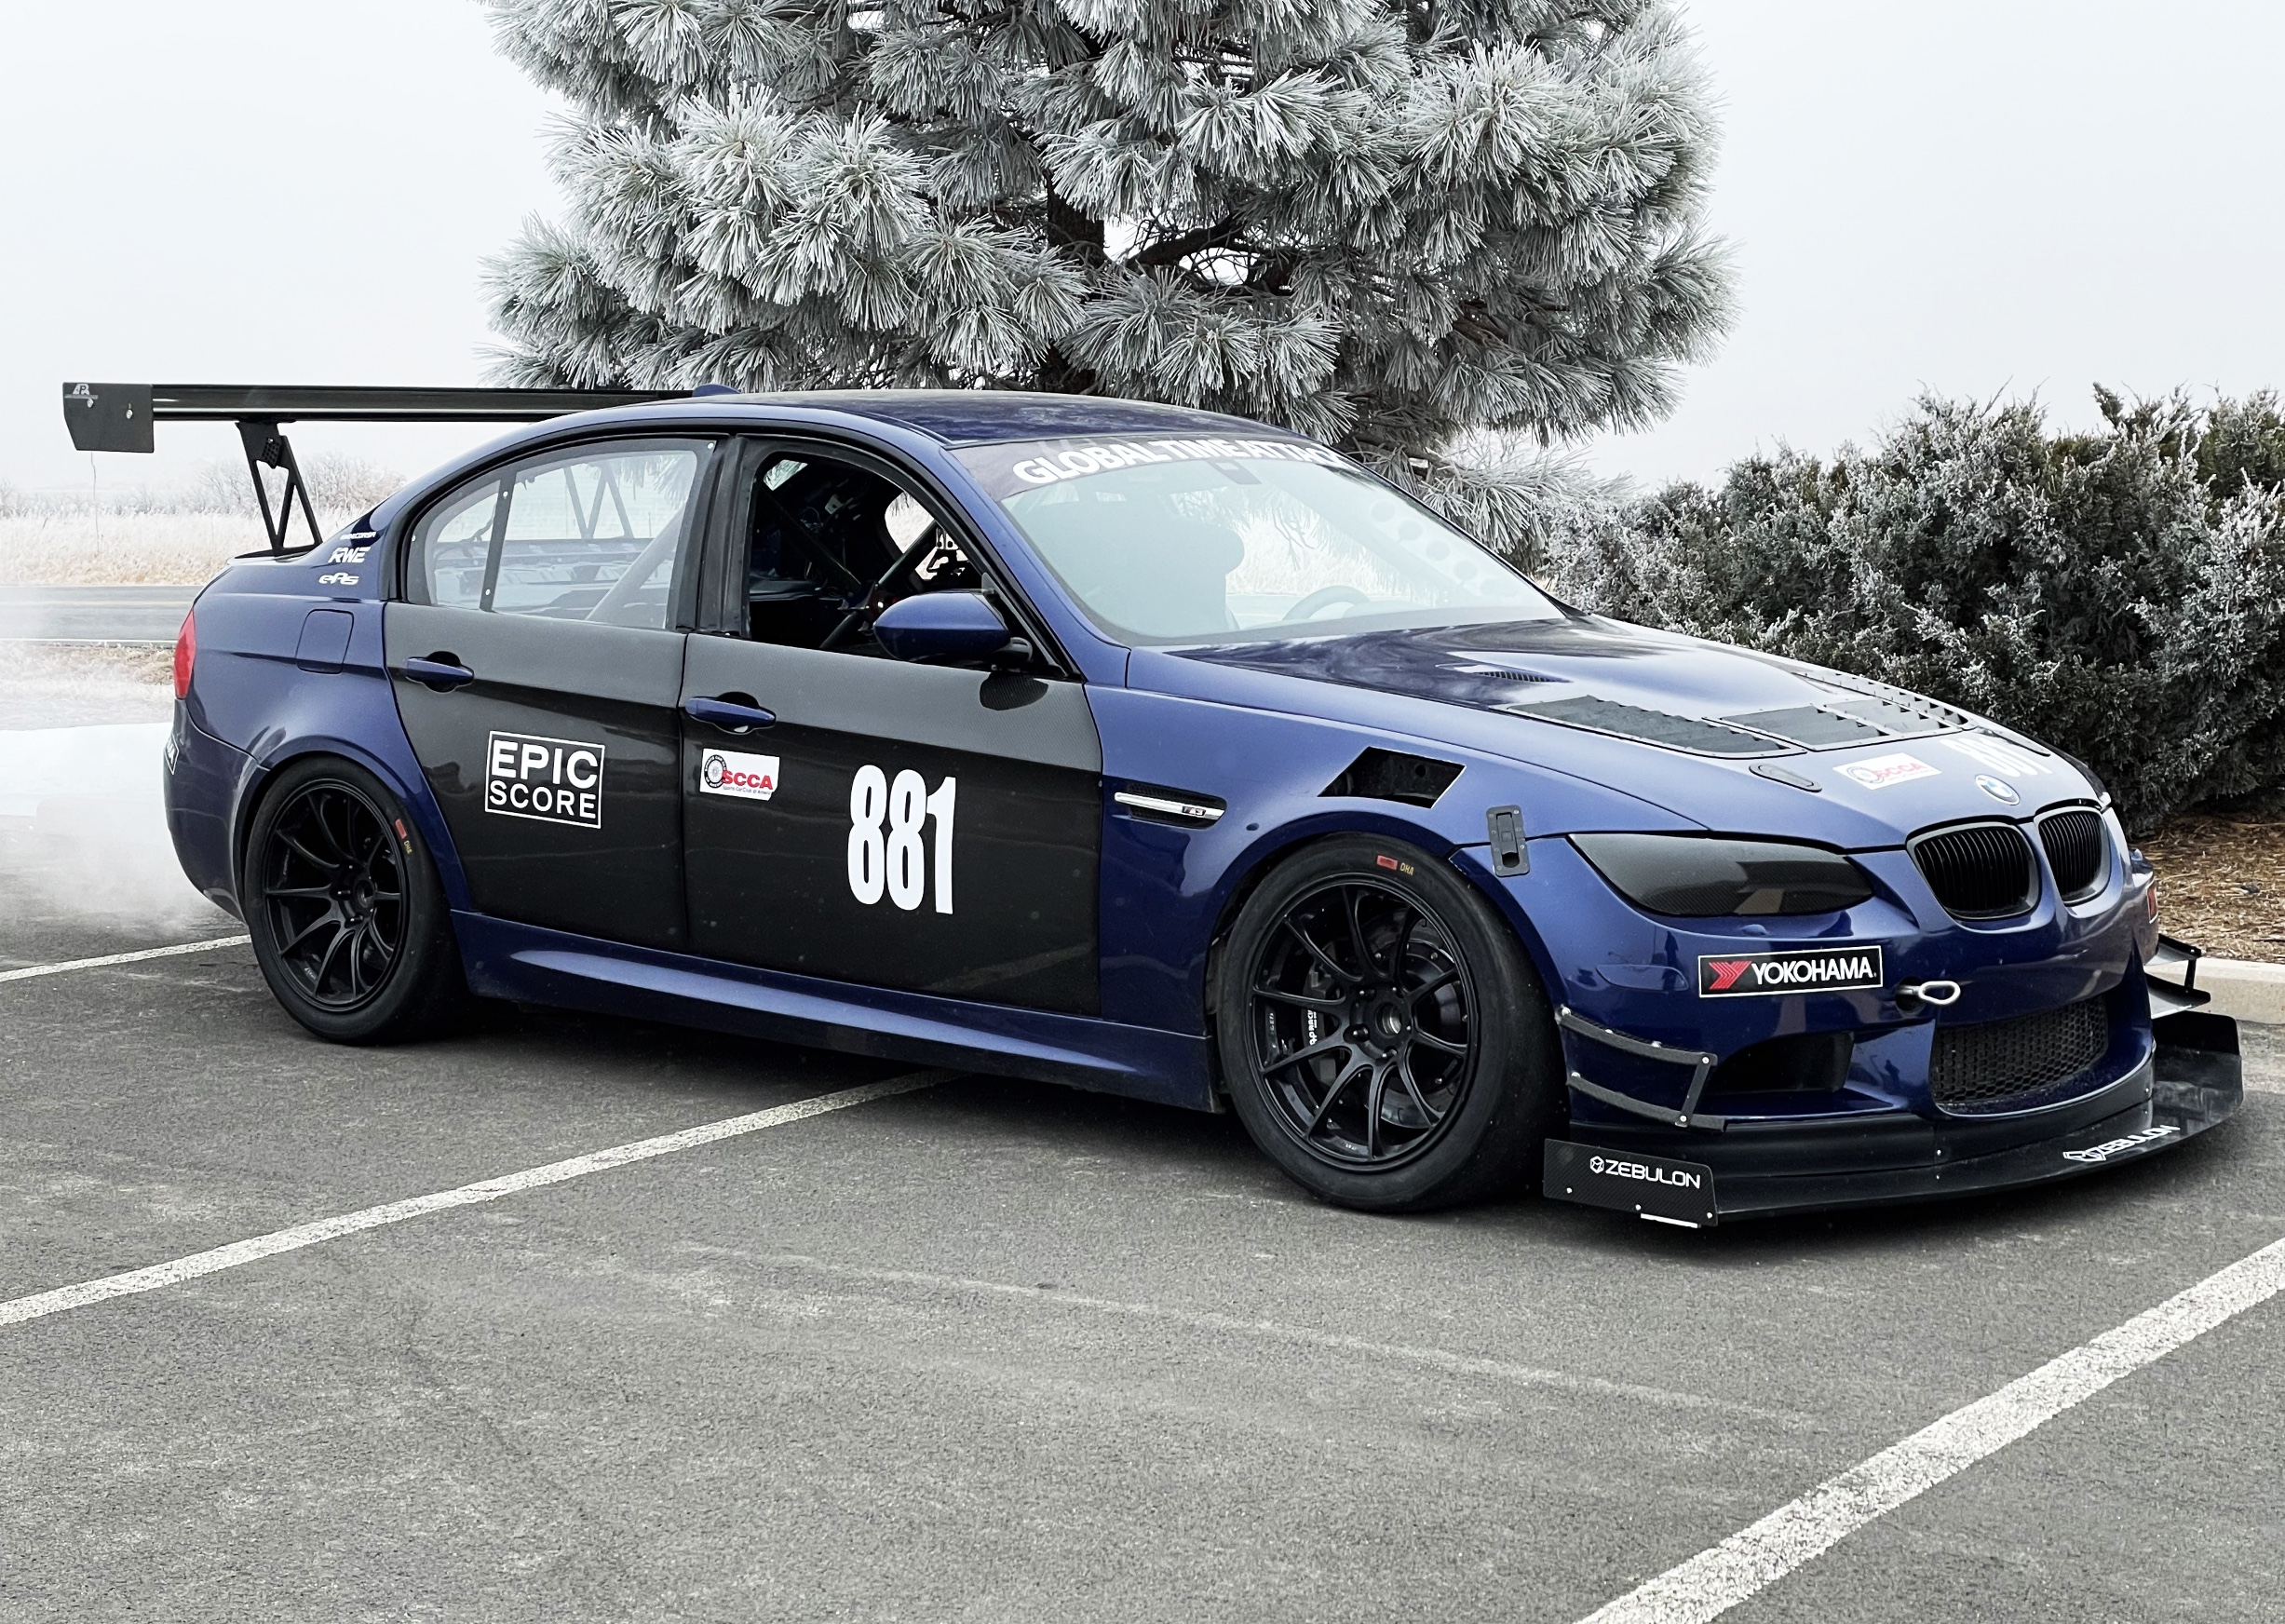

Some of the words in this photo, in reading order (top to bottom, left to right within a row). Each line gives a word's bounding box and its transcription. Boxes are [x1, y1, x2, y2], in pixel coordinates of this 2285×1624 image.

[1012, 442, 1173, 484] GLOBAL
[1147, 440, 1251, 460] TIME
[491, 739, 599, 790] EPIC
[1873, 762, 1928, 779] SCCA
[1939, 737, 2054, 778] 881
[489, 779, 597, 819] SCORE
[722, 769, 774, 791] SCCA
[847, 764, 957, 915] 881
[1751, 956, 1873, 985] YOKOHAMA
[1604, 1158, 1701, 1189] ZEBULON
